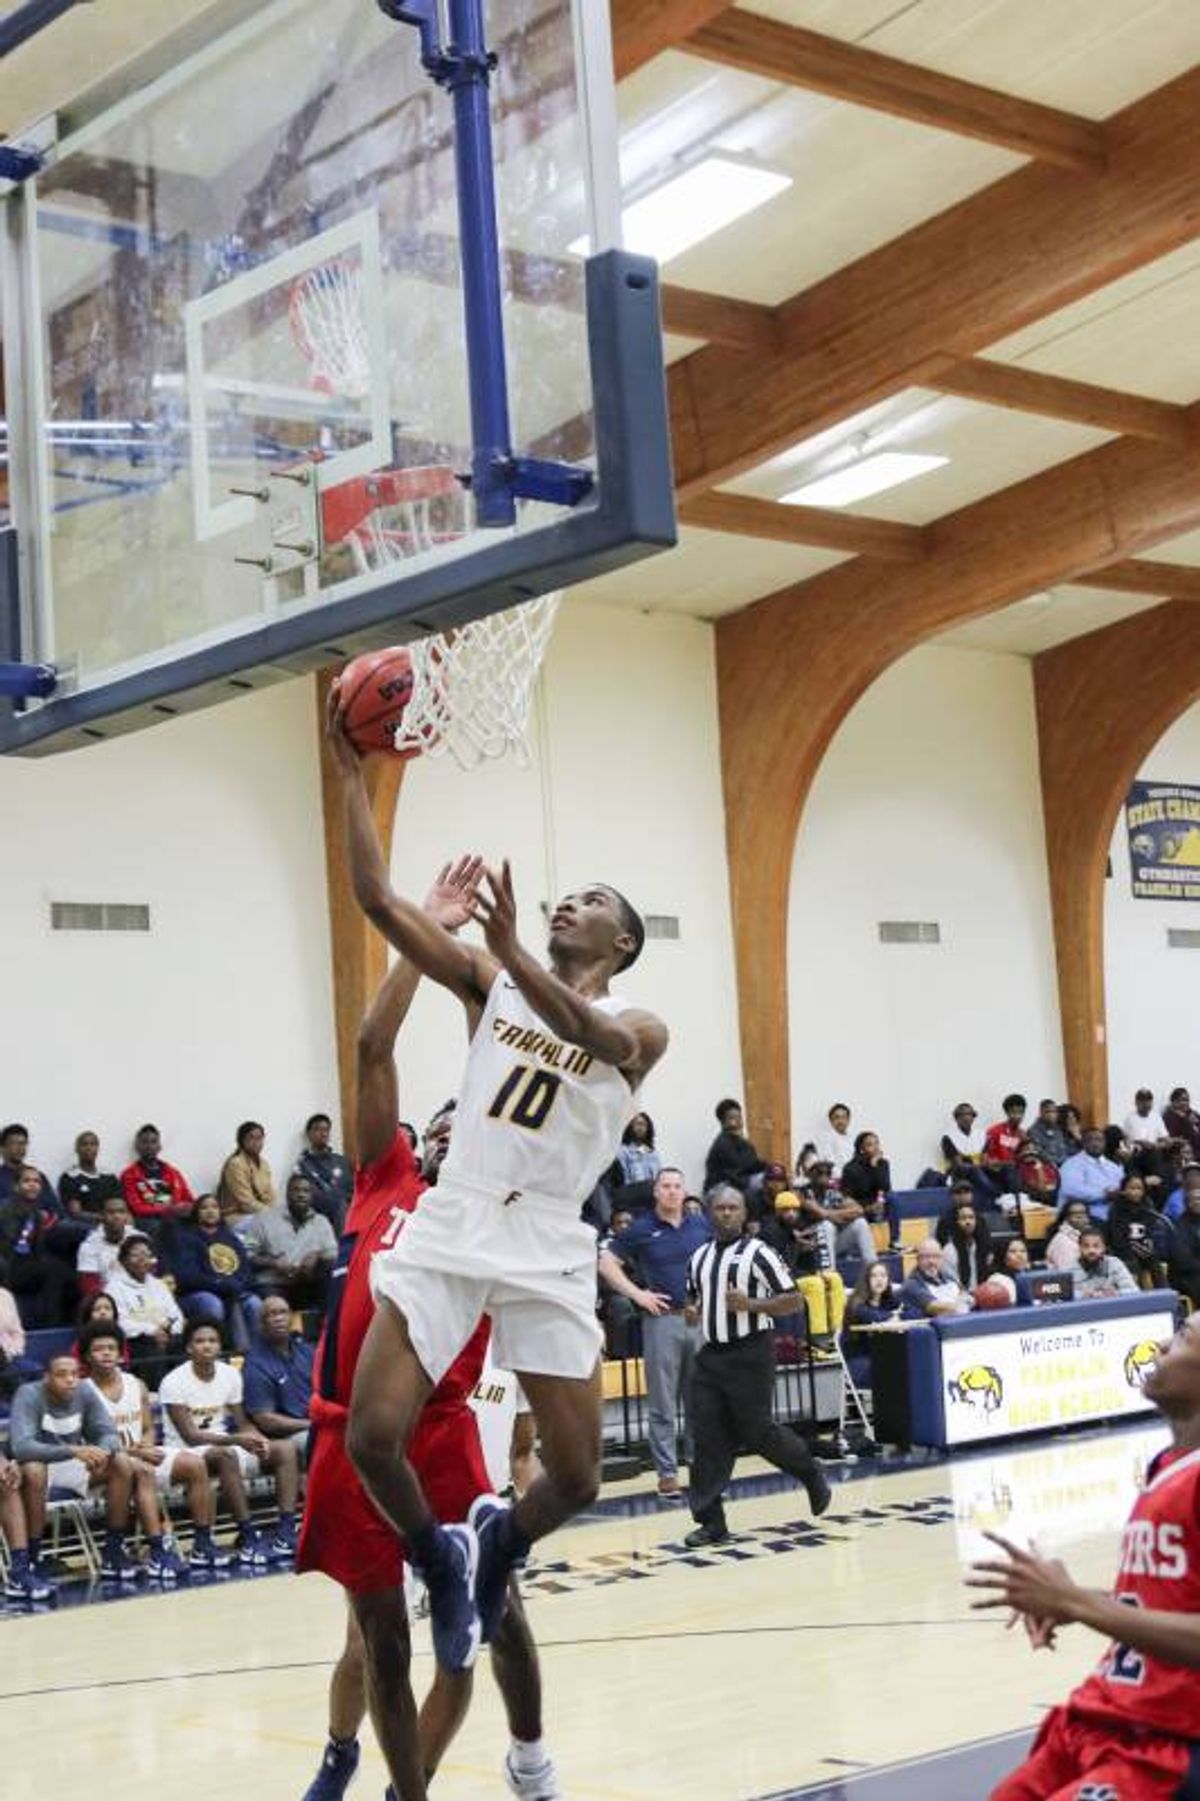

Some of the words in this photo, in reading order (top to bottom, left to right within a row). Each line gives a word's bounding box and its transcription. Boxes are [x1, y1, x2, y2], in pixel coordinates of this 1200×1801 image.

[488, 1065, 562, 1130] 10
[504, 1190, 523, 1207] F
[1019, 1334, 1083, 1356] Welcome
[1087, 1328, 1106, 1347] To
